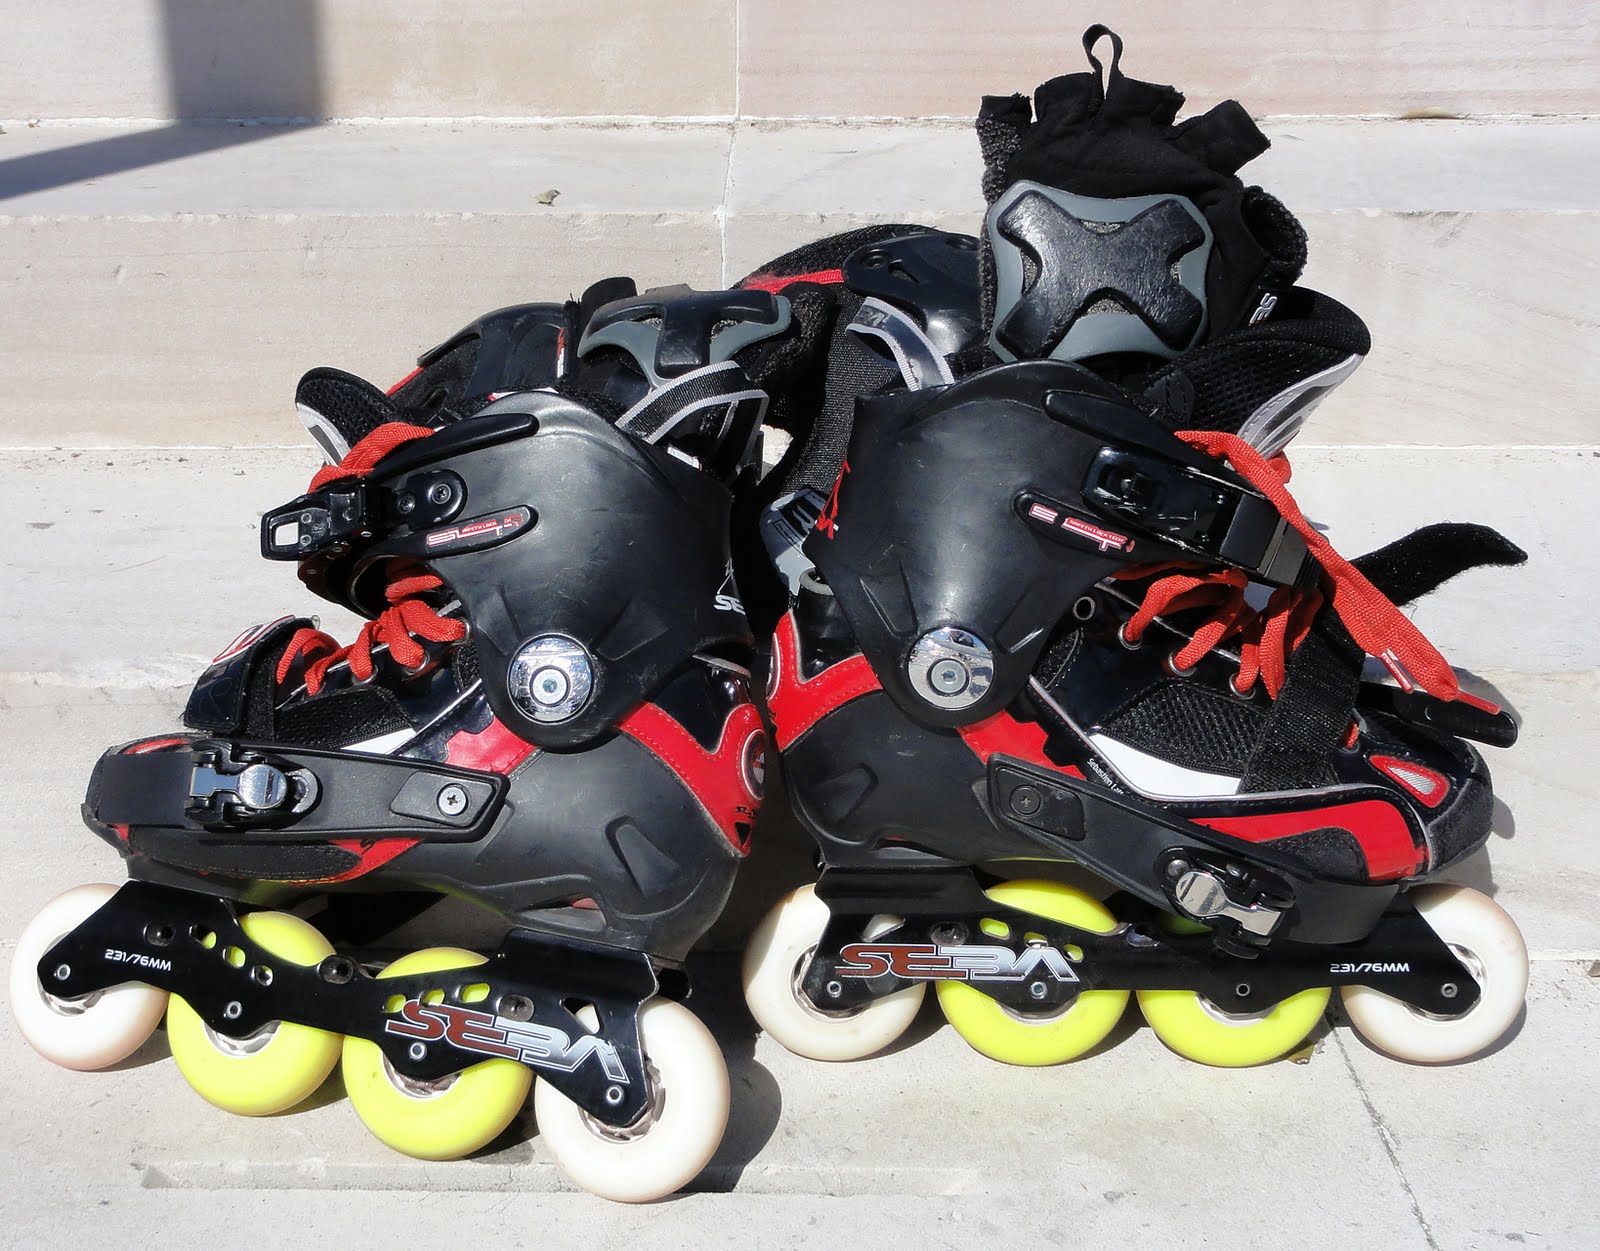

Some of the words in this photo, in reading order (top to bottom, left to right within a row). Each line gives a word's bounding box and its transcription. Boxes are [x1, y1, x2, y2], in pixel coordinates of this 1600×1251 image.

[1087, 758, 1112, 787] Sebastien
[104, 948, 173, 972] 231/76MM
[834, 943, 1081, 983] SEBA
[1329, 962, 1411, 974] 231/76MM
[385, 999, 631, 1083] SEBA
